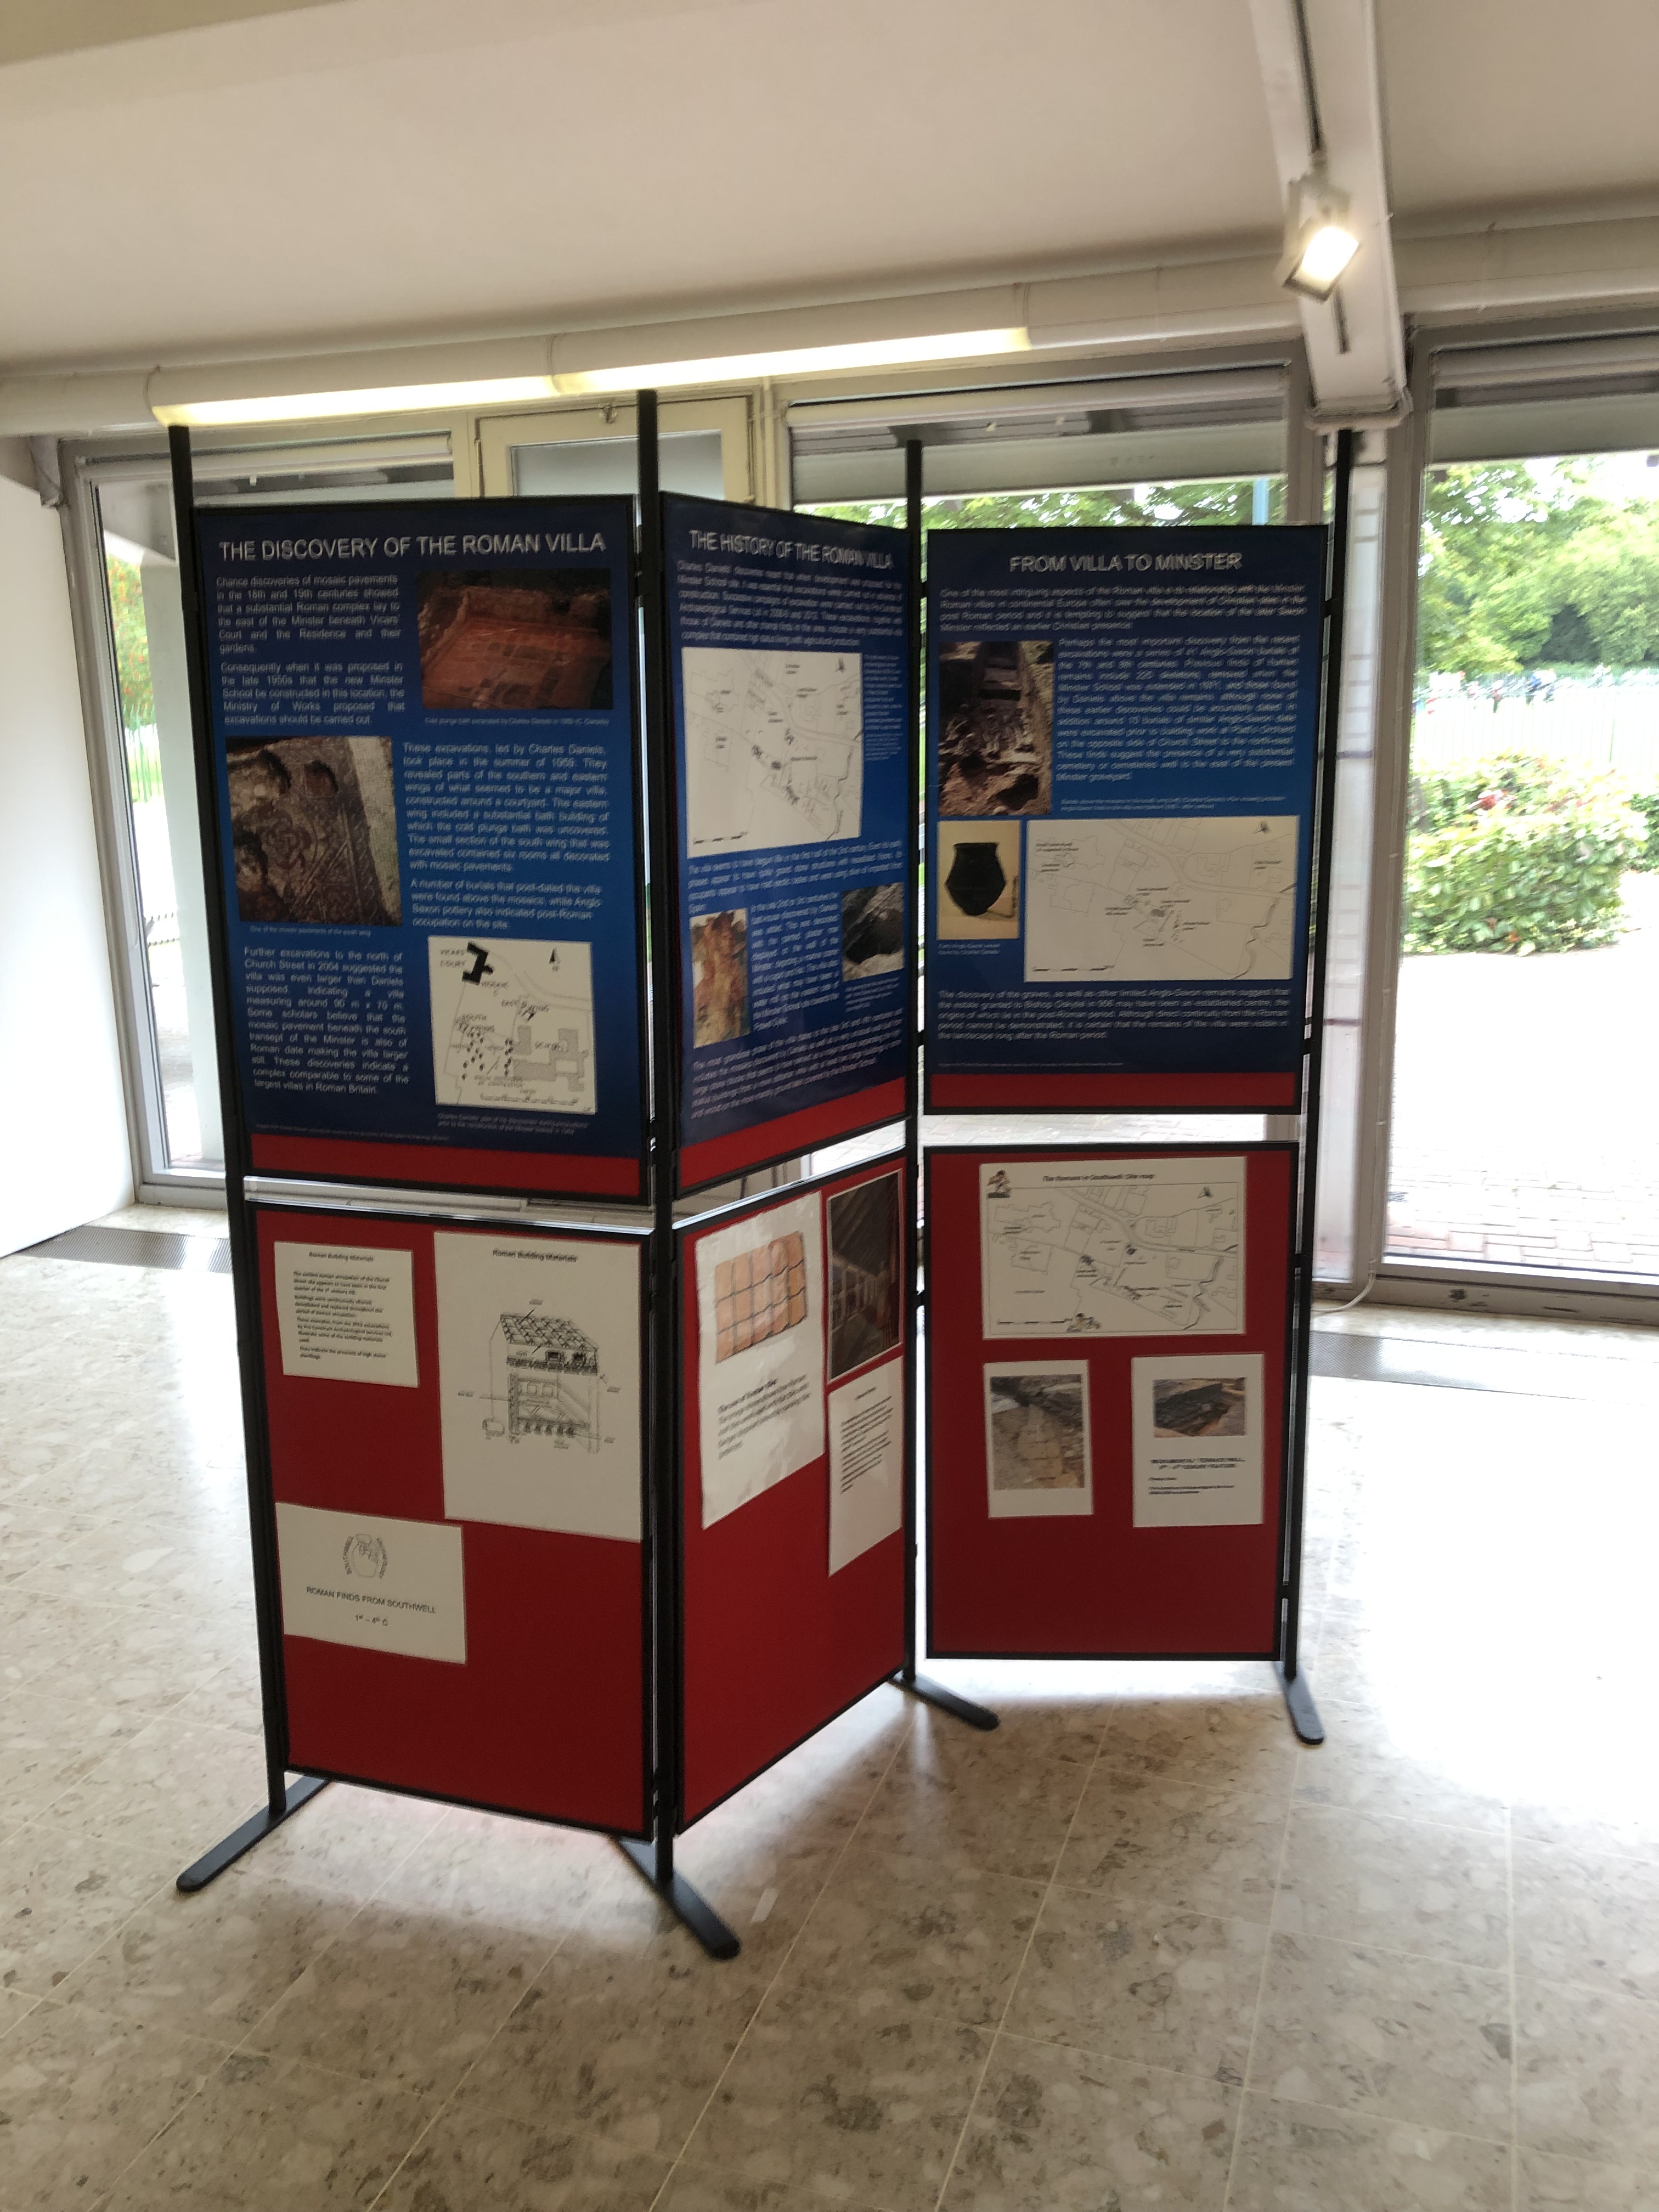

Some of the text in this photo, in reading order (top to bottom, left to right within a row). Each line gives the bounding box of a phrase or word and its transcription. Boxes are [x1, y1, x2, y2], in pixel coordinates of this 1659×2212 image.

[219, 533, 605, 560] THE DISCOVERY OF THE ROMAN VILLA
[689, 530, 718, 551] THE
[720, 534, 774, 556] HISTORY
[776, 540, 792, 559] OF
[796, 543, 820, 562] THE
[822, 546, 865, 567] ROMAN
[1009, 553, 1242, 572] FROM VILLA TO MINSTER
[306, 1586, 436, 1613] ROMAN FINDS FROM SOUTHWELL
